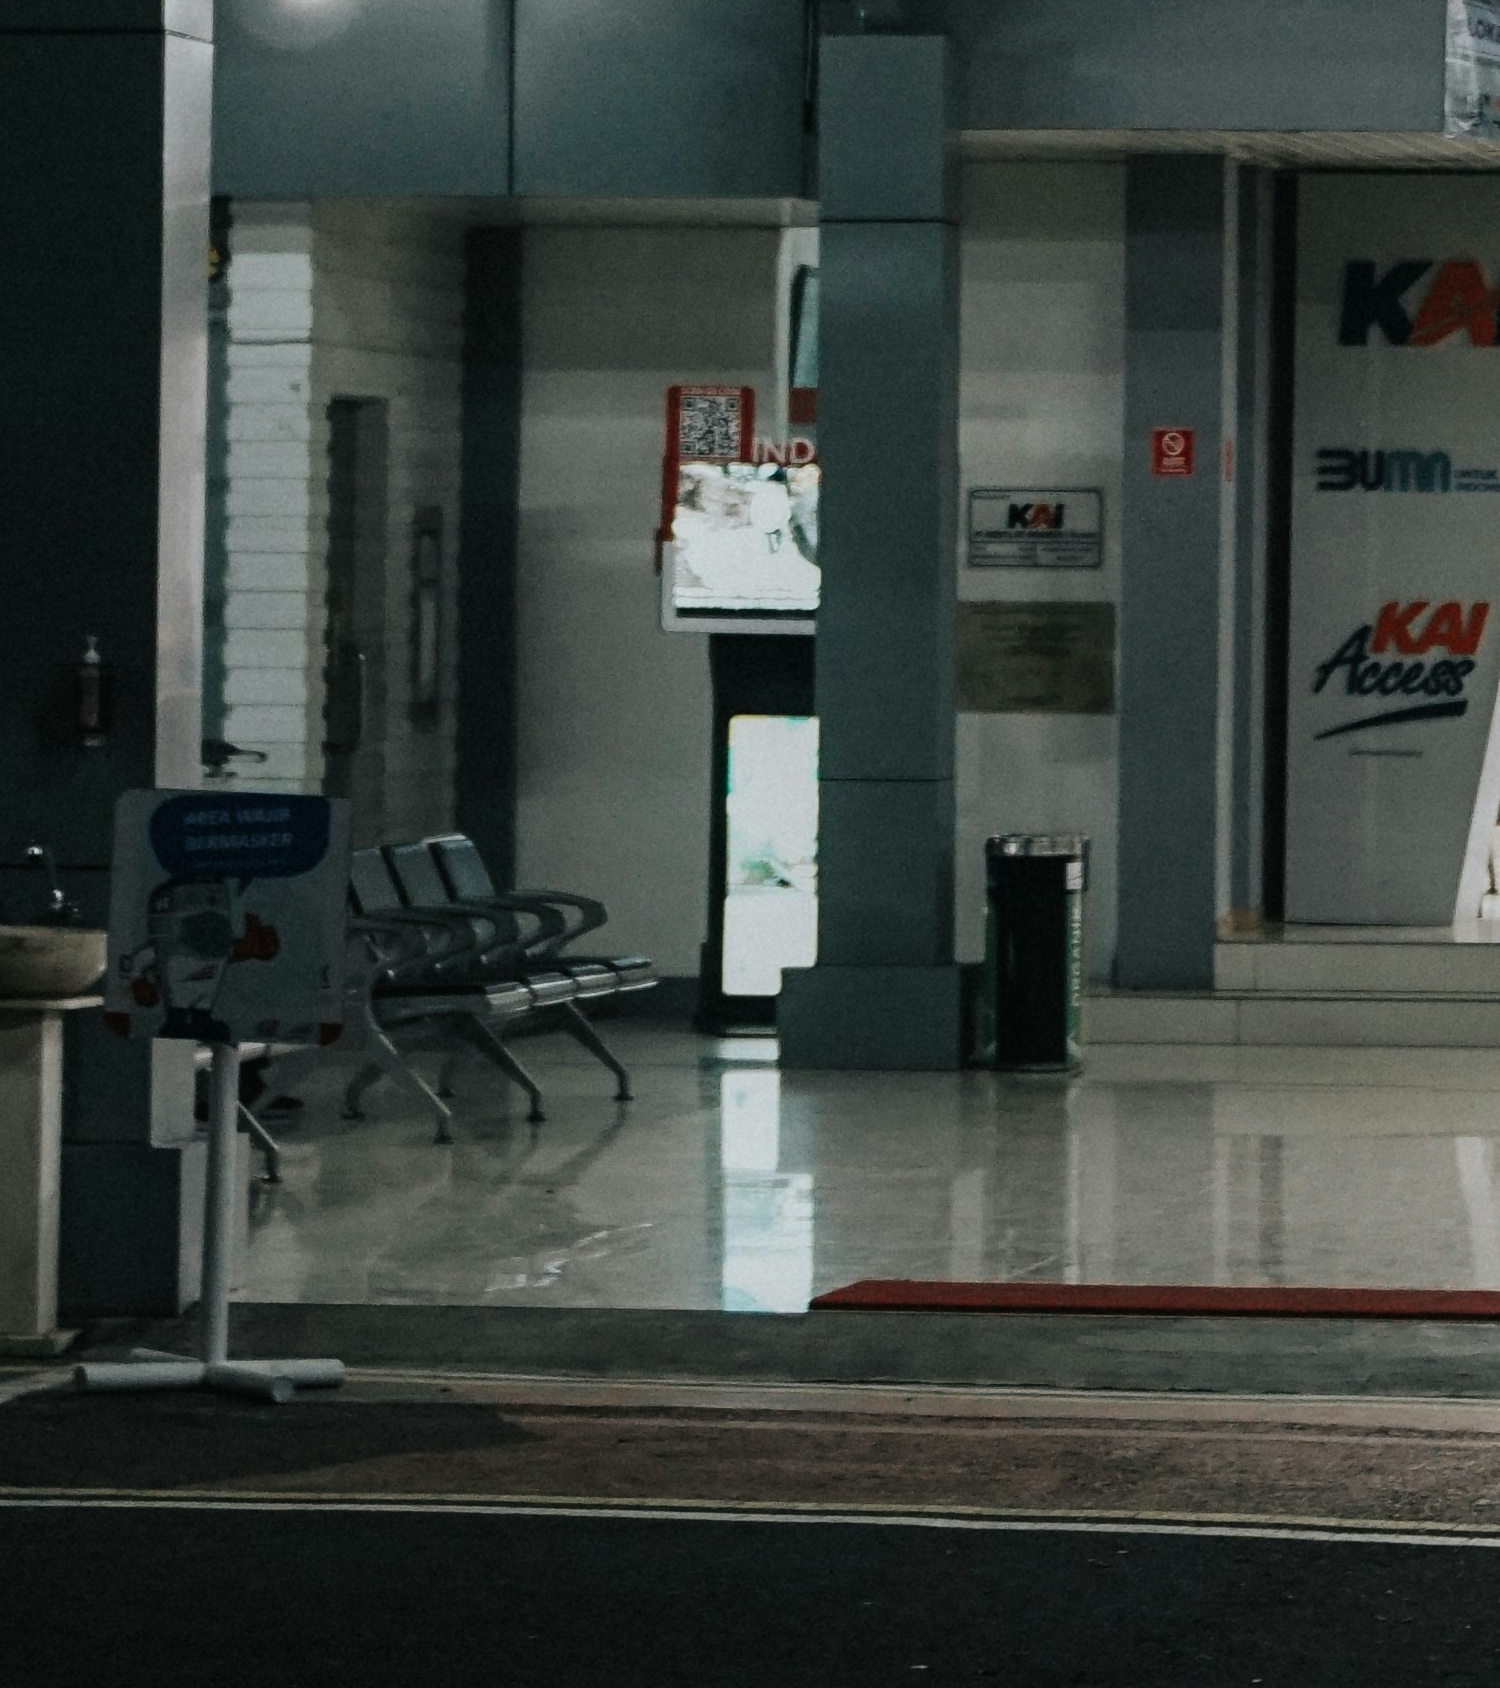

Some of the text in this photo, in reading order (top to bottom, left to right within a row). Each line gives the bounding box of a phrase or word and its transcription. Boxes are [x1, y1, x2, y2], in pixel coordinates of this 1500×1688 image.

[1006, 502, 1066, 530] KAI
[1372, 601, 1491, 656] KAI
[1314, 622, 1476, 697] Access
